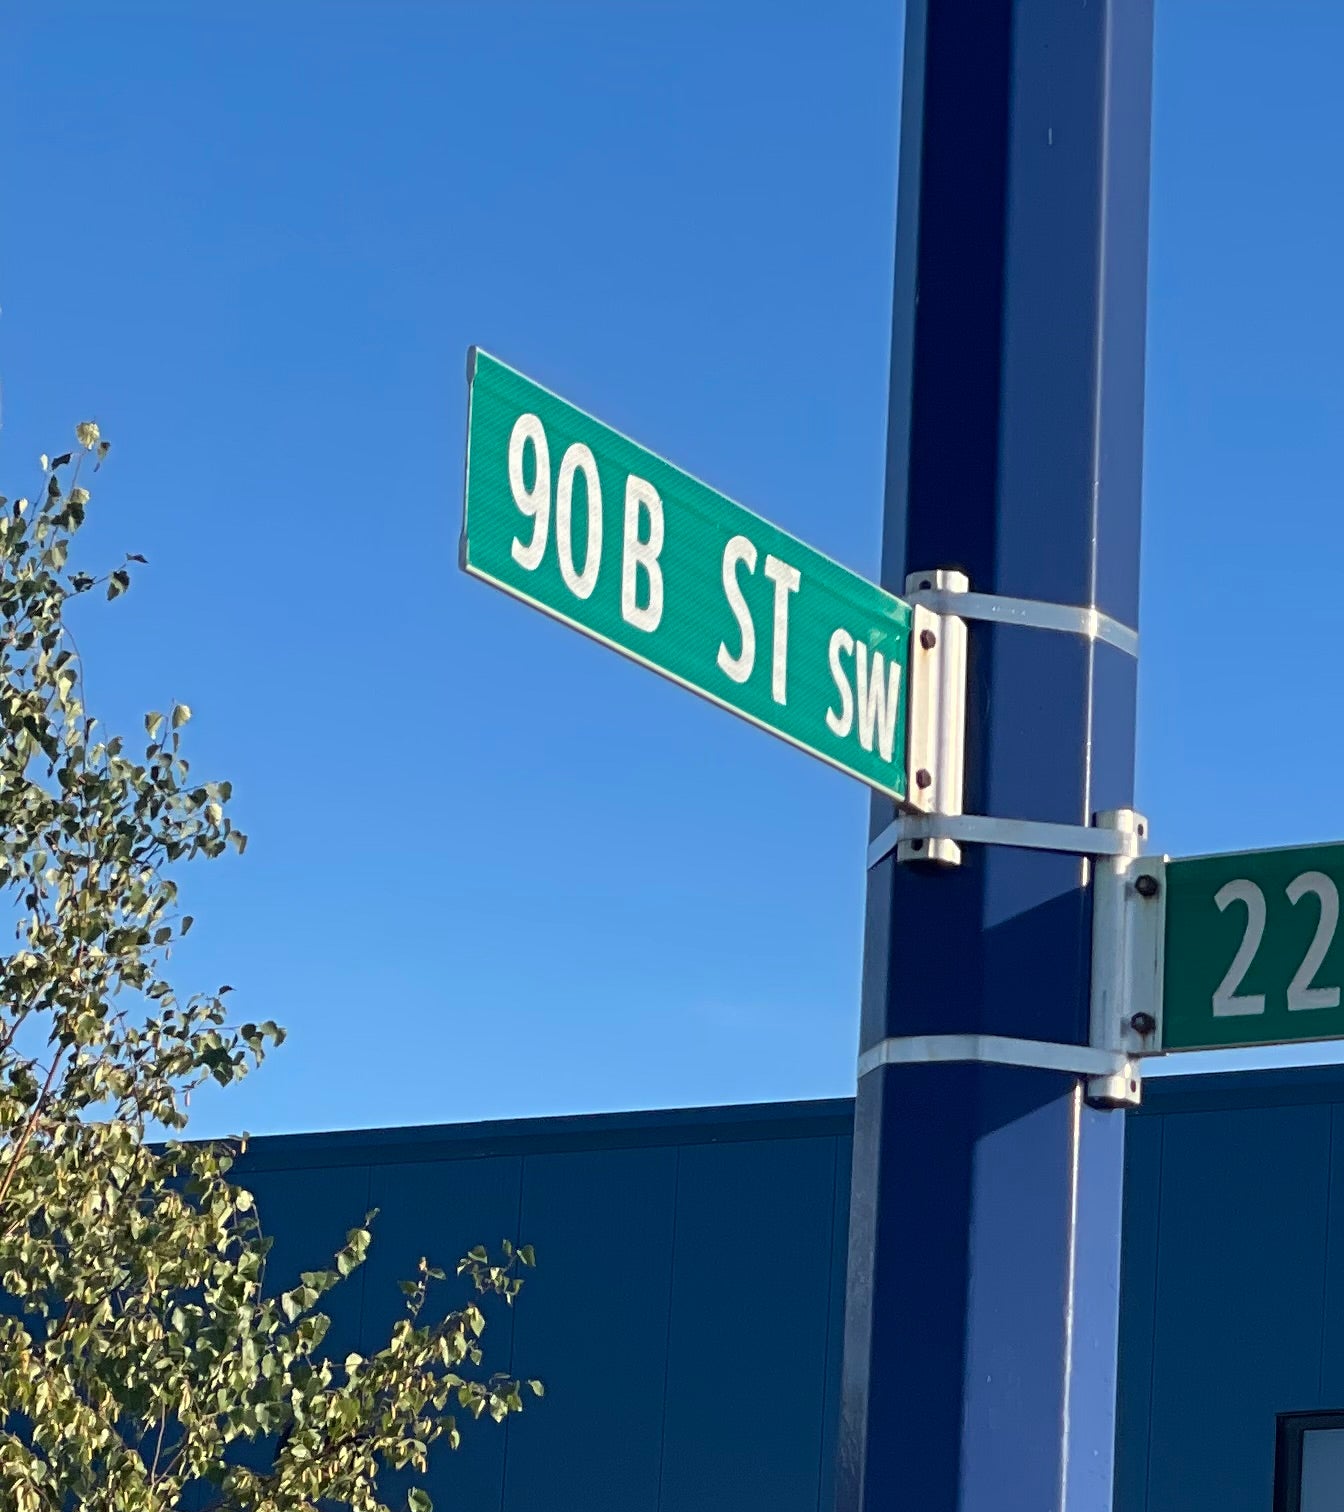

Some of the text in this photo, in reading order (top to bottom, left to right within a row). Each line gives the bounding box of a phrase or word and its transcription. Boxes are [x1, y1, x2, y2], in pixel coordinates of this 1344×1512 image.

[716, 534, 802, 706] ST
[826, 627, 902, 763] SW
[1212, 871, 1341, 1017] 22
